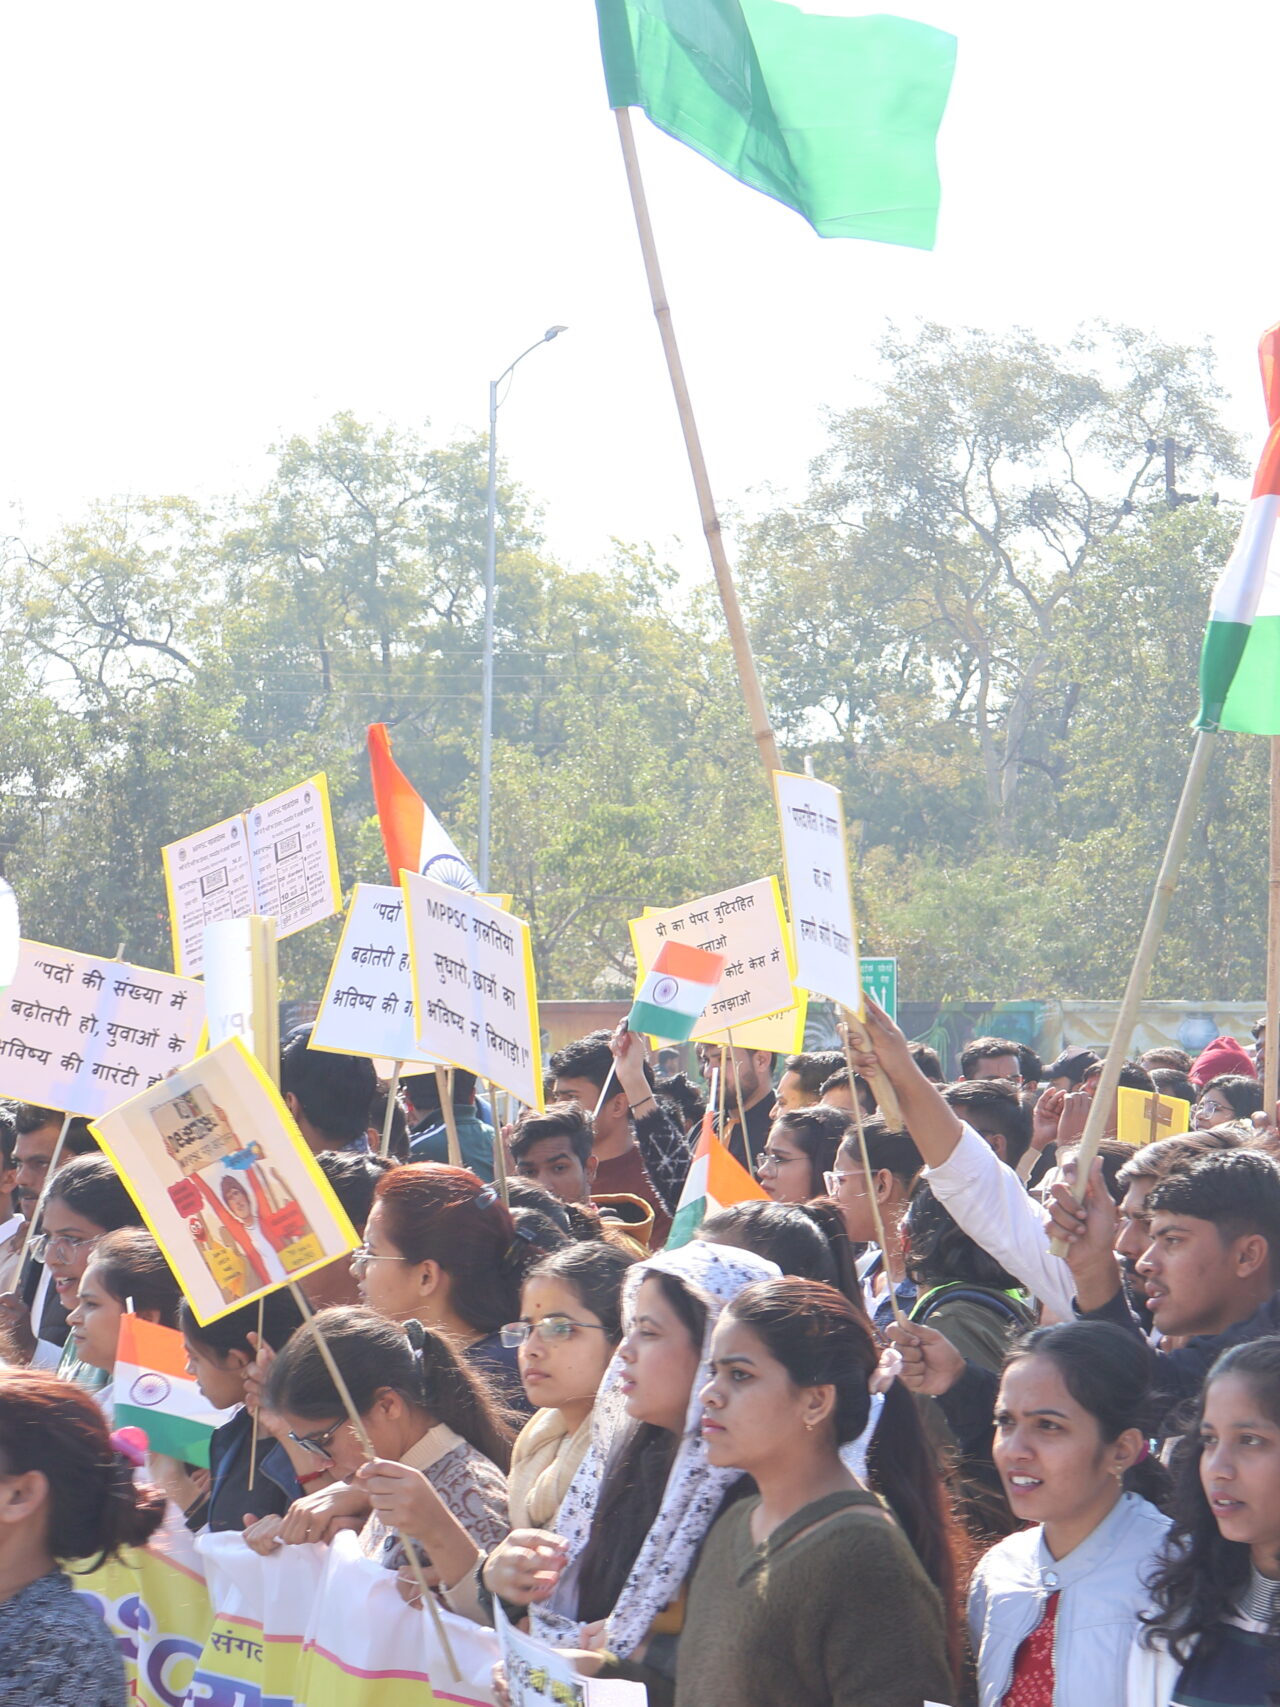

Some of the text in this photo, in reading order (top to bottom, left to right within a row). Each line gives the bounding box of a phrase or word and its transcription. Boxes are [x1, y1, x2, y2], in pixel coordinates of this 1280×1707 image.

[426, 898, 468, 932] MPPSC
[671, 919, 685, 932] का
[689, 911, 710, 926] पेपर
[713, 895, 755, 924] त्रुटिरहित
[350, 943, 396, 968] बढ़ोतरी
[724, 946, 780, 979] कोर्ट केस में
[82, 970, 105, 991] की
[113, 976, 163, 1005] संख्या
[170, 990, 188, 1011] में
[332, 986, 377, 1012] भविष्य
[381, 992, 399, 1014] की
[502, 985, 516, 1011] का
[711, 991, 751, 1014] उलझाओ
[10, 998, 72, 1027] बढ़ोतरी
[106, 1022, 160, 1048] युवाओं
[168, 1033, 186, 1053] के
[426, 998, 466, 1035] भविष्य
[470, 1021, 480, 1042] न
[60, 1052, 84, 1074] की
[91, 1062, 140, 1087] गारंटी
